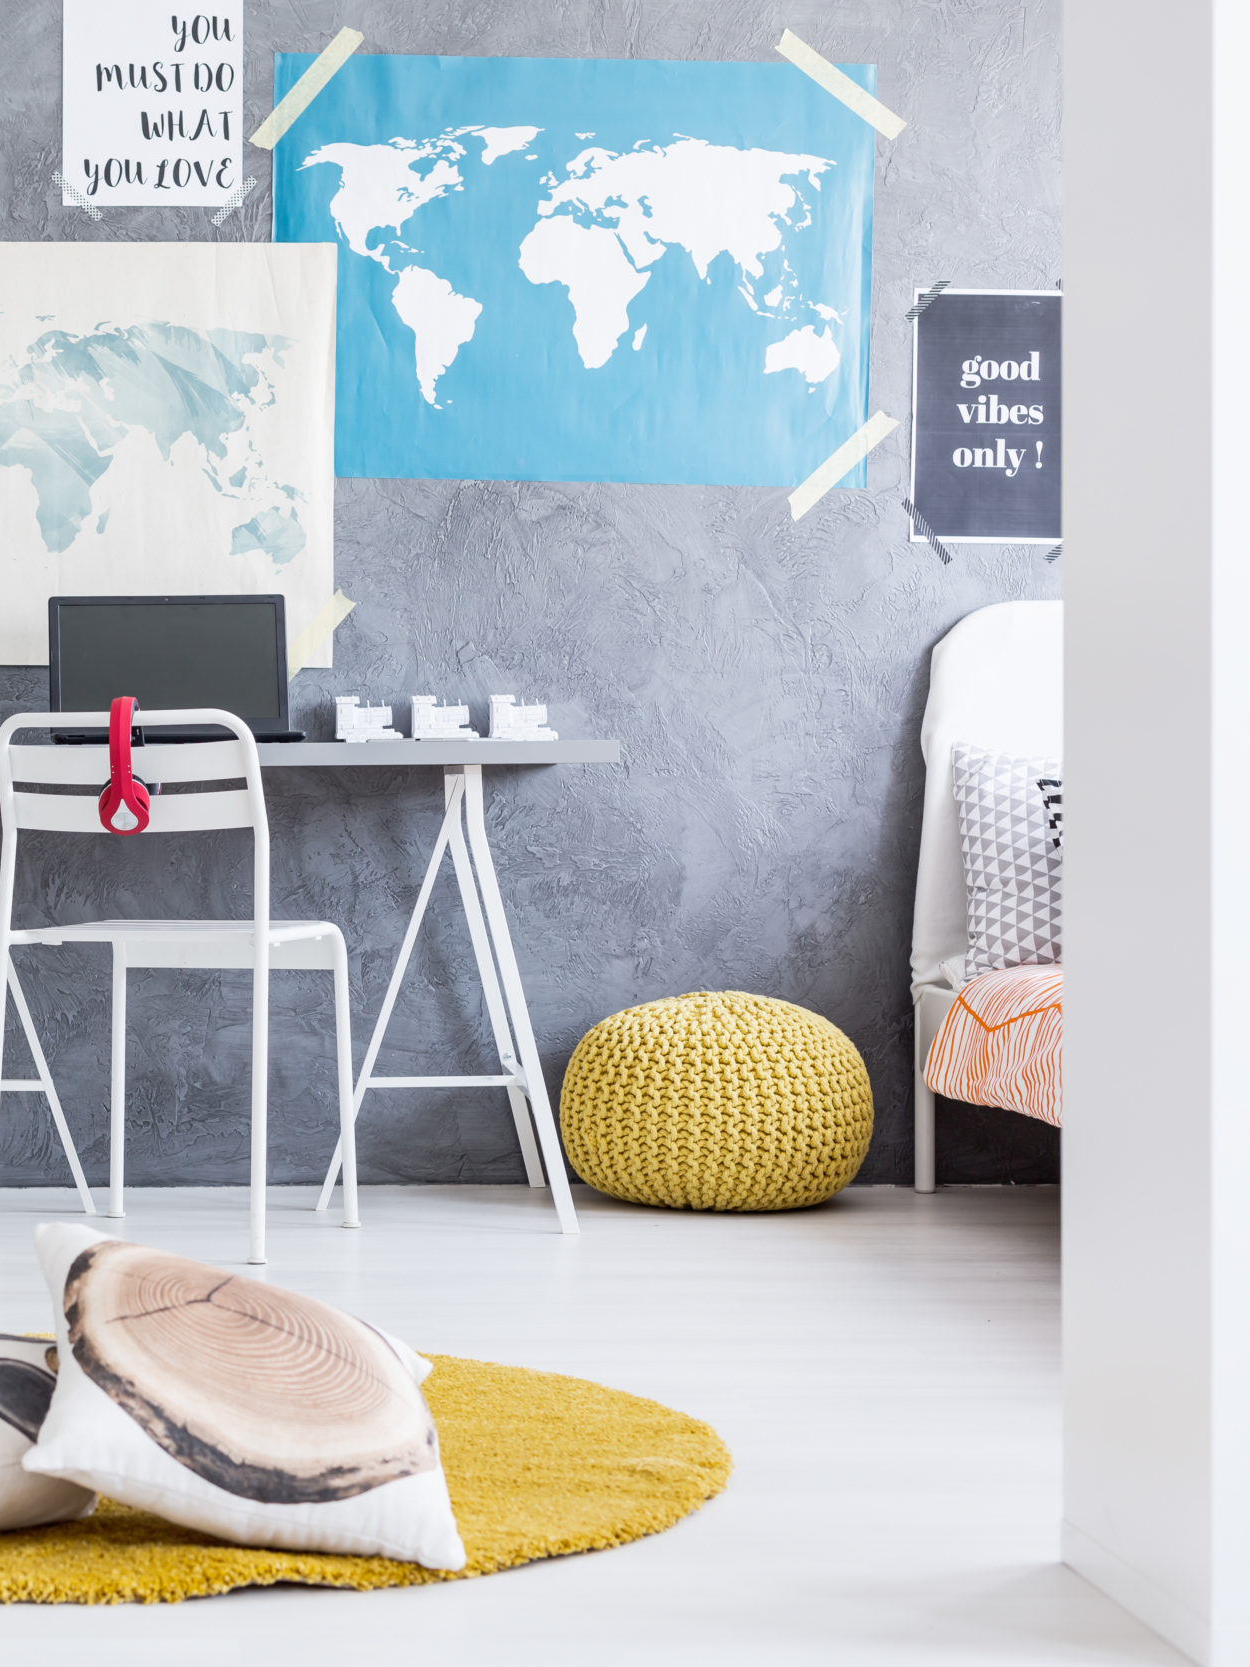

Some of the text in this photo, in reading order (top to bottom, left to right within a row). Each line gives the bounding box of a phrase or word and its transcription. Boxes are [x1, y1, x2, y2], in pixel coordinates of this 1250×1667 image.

[171, 14, 236, 53] YOU
[95, 61, 235, 93] MUST DO
[140, 108, 234, 142] WHAT
[83, 157, 235, 196] YOU LOVE
[959, 351, 1041, 389] good
[956, 394, 1044, 425] vibes
